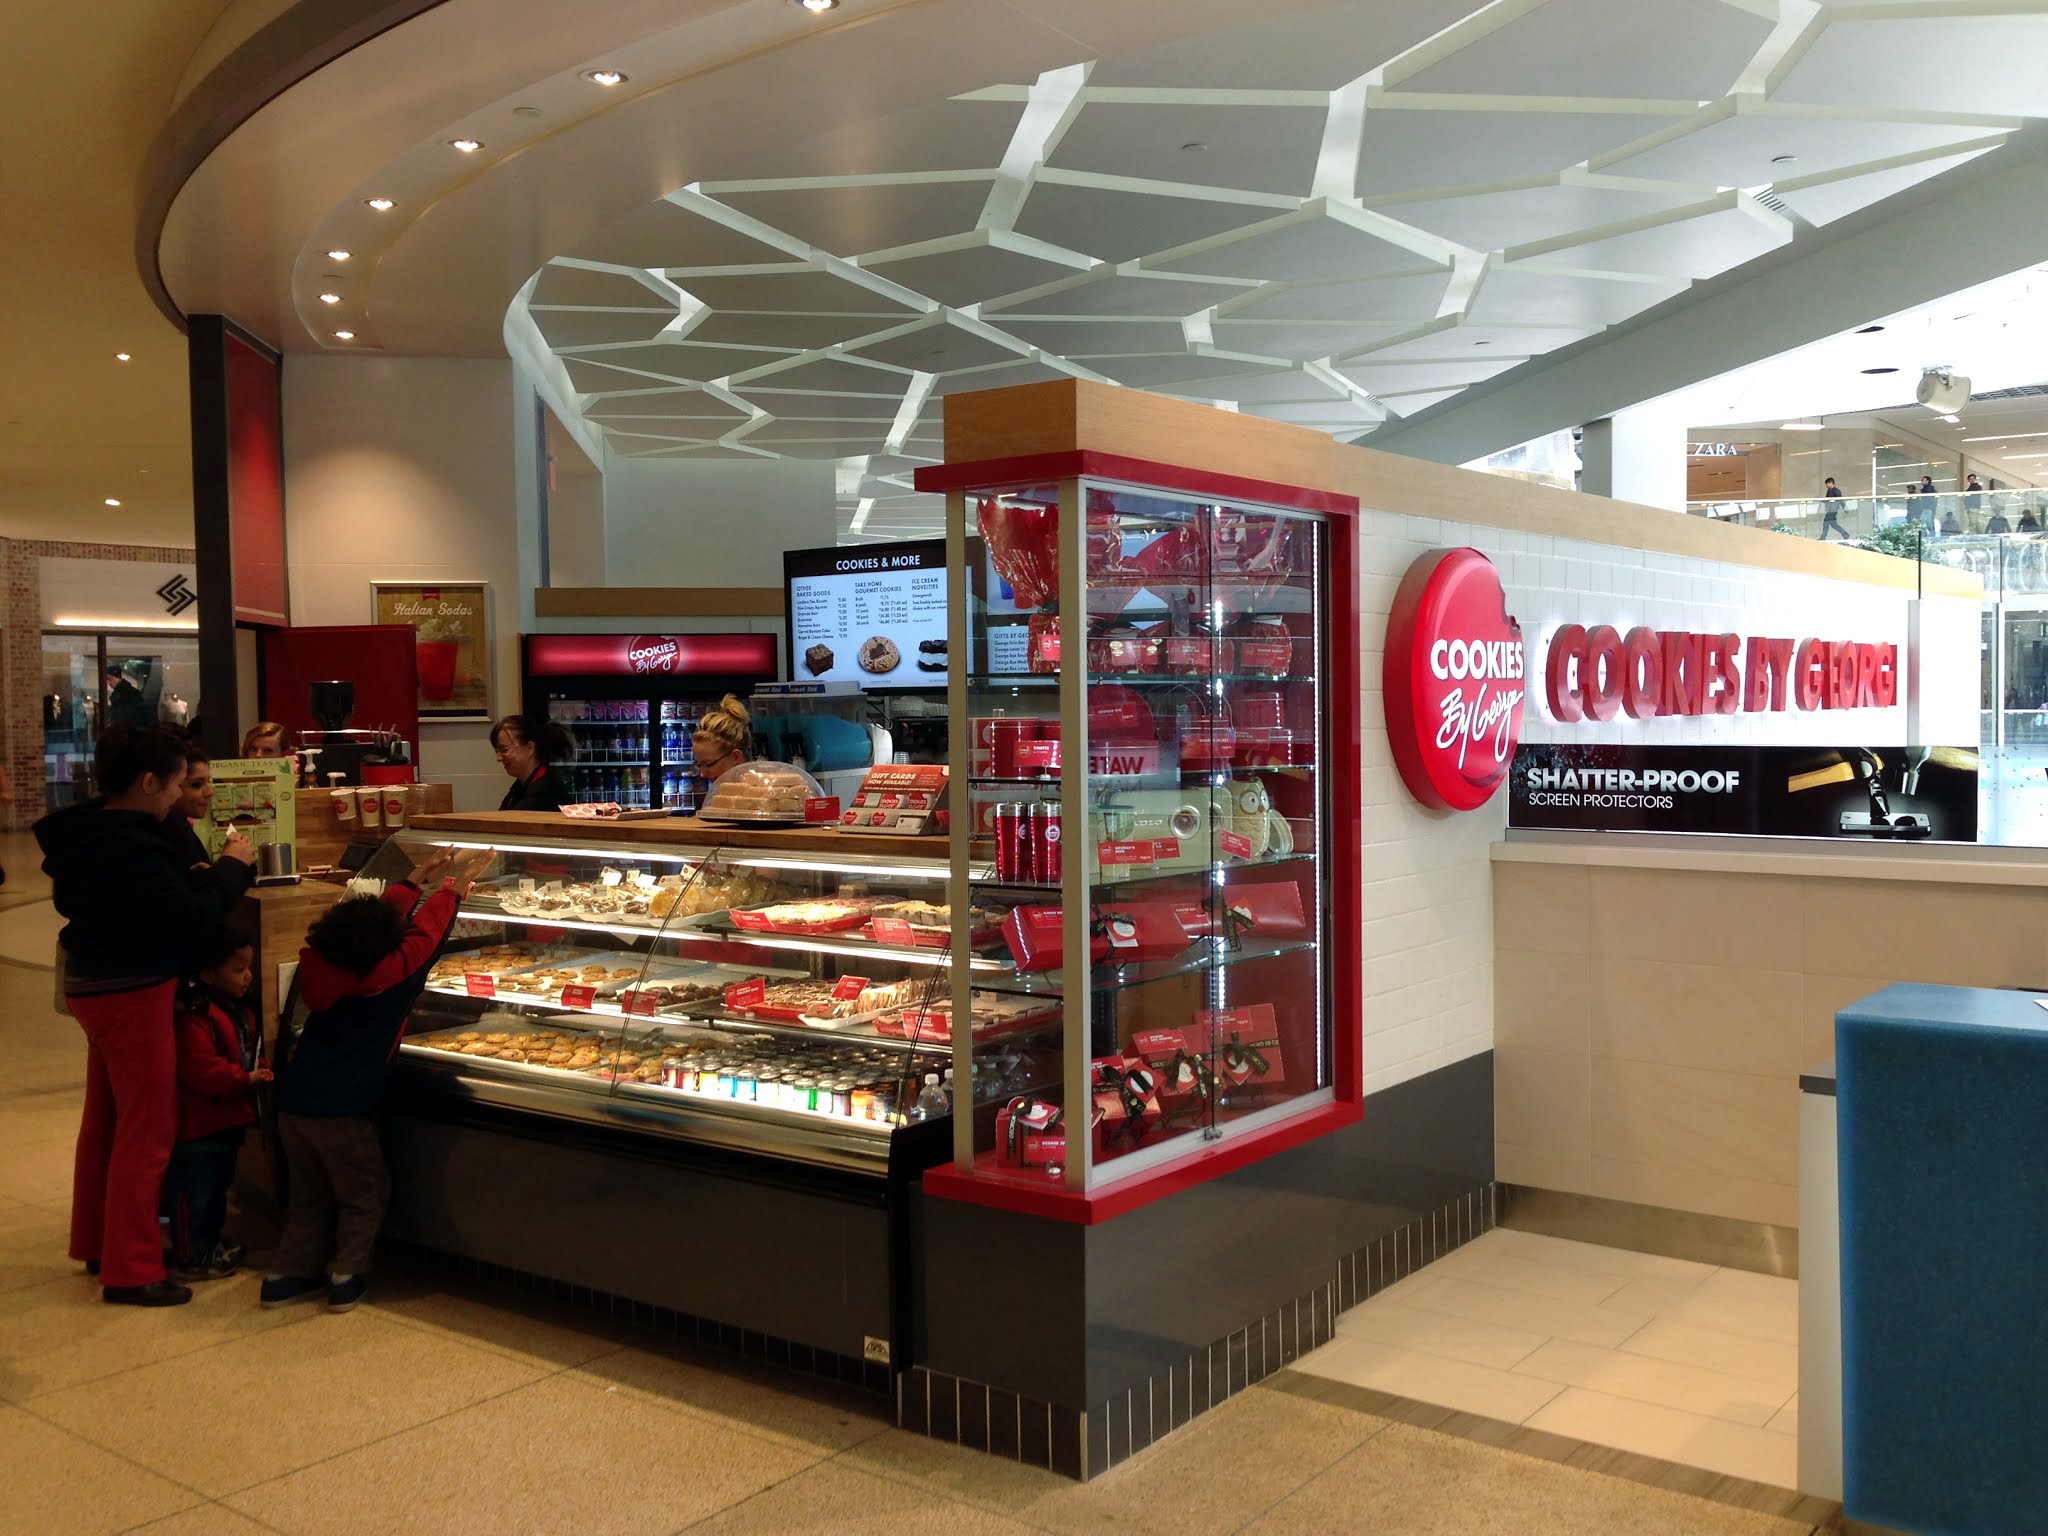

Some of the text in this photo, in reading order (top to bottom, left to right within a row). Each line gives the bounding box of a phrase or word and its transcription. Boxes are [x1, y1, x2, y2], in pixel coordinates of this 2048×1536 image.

[1695, 443, 1737, 456] ZARA
[836, 555, 921, 571] COOKIES & MORE
[392, 602, 473, 616] Italian Sodas
[629, 642, 676, 661] COOKIES
[1430, 639, 1524, 680] COOKIES
[636, 651, 678, 675] By George
[1546, 623, 1898, 723] COOKIES BY GEORG
[1436, 682, 1524, 770] By George
[209, 760, 274, 769] ORGANIC TEAS
[871, 772, 889, 780] GIFT
[1527, 767, 1740, 793] SHATTER-PROOF
[1529, 792, 1673, 809] SCREEN PROTECTORS
